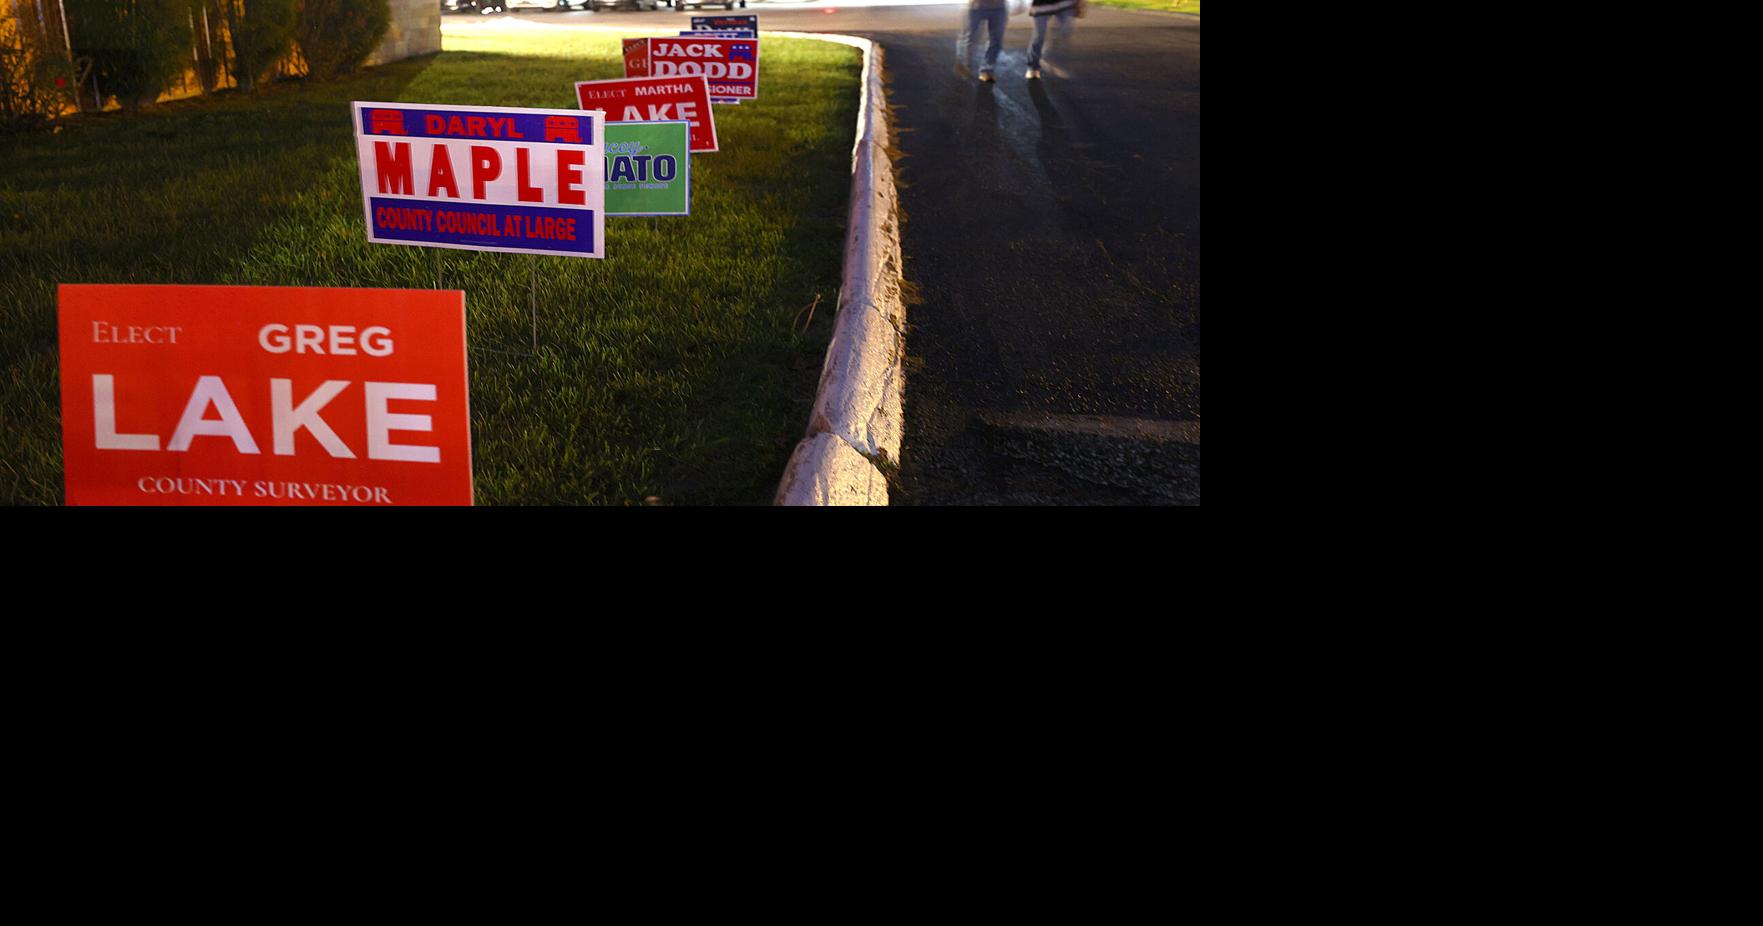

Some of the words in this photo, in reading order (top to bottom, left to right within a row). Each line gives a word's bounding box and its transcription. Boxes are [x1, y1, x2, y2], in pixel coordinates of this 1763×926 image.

[653, 43, 723, 57] JACK
[653, 61, 752, 80] DODD
[588, 89, 628, 99] ELECT
[634, 83, 694, 97] MARTHA
[424, 114, 524, 139] DARYL
[594, 101, 700, 127] AKE
[373, 141, 587, 205] MAPLE
[376, 206, 434, 232] COUNTY
[436, 210, 501, 237] COUNCIL
[504, 215, 523, 239] AT
[525, 215, 577, 241] LARGE
[258, 323, 394, 357] GREG
[91, 373, 441, 464] LAKE
[137, 476, 247, 497] COUNTY
[254, 480, 393, 504] SURVEYOR
